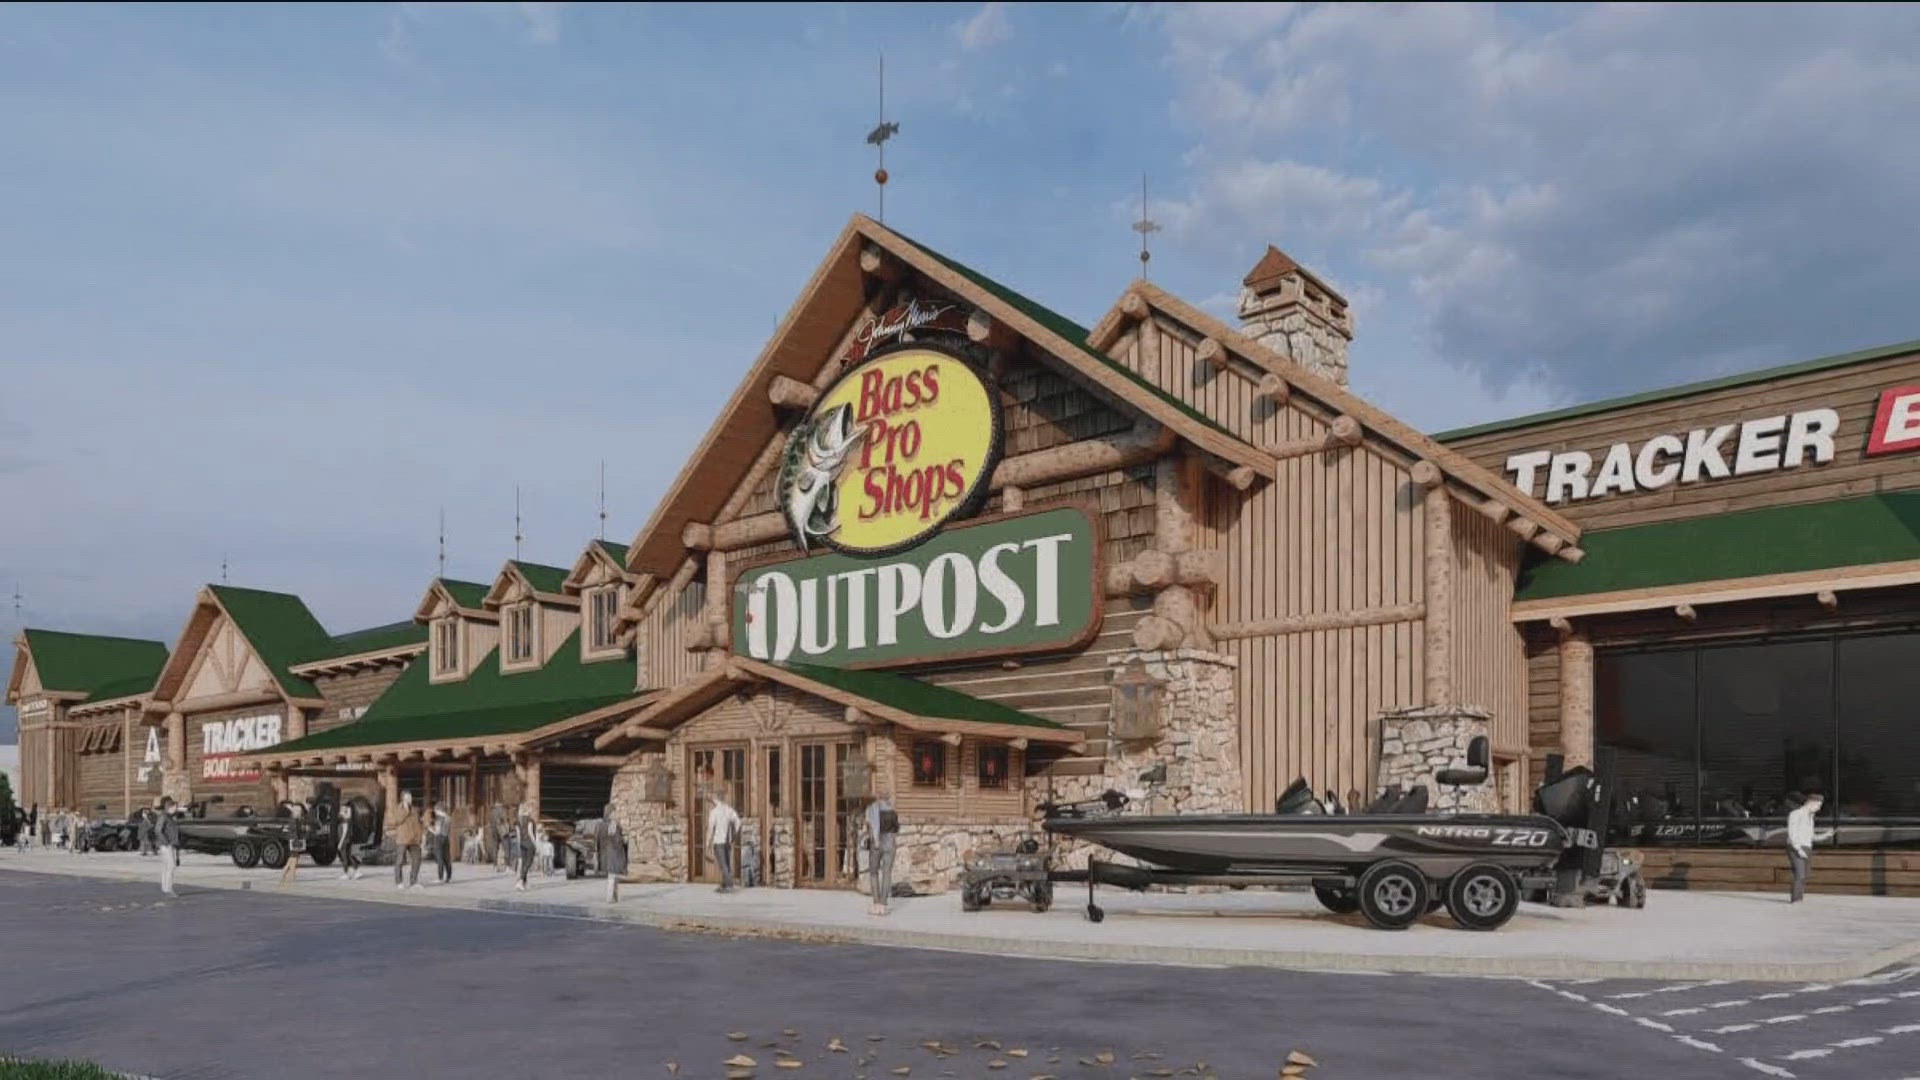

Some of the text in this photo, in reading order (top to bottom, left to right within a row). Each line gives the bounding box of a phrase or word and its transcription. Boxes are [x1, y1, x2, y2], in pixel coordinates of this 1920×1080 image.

[856, 364, 940, 423] Bass
[858, 419, 921, 471] Pro
[1506, 408, 1840, 503] TRACKER
[858, 458, 966, 519] Shops
[746, 533, 1072, 662] OUTPOST
[202, 714, 282, 754] TRACKER
[1417, 826, 1549, 848] NITRO Z20
